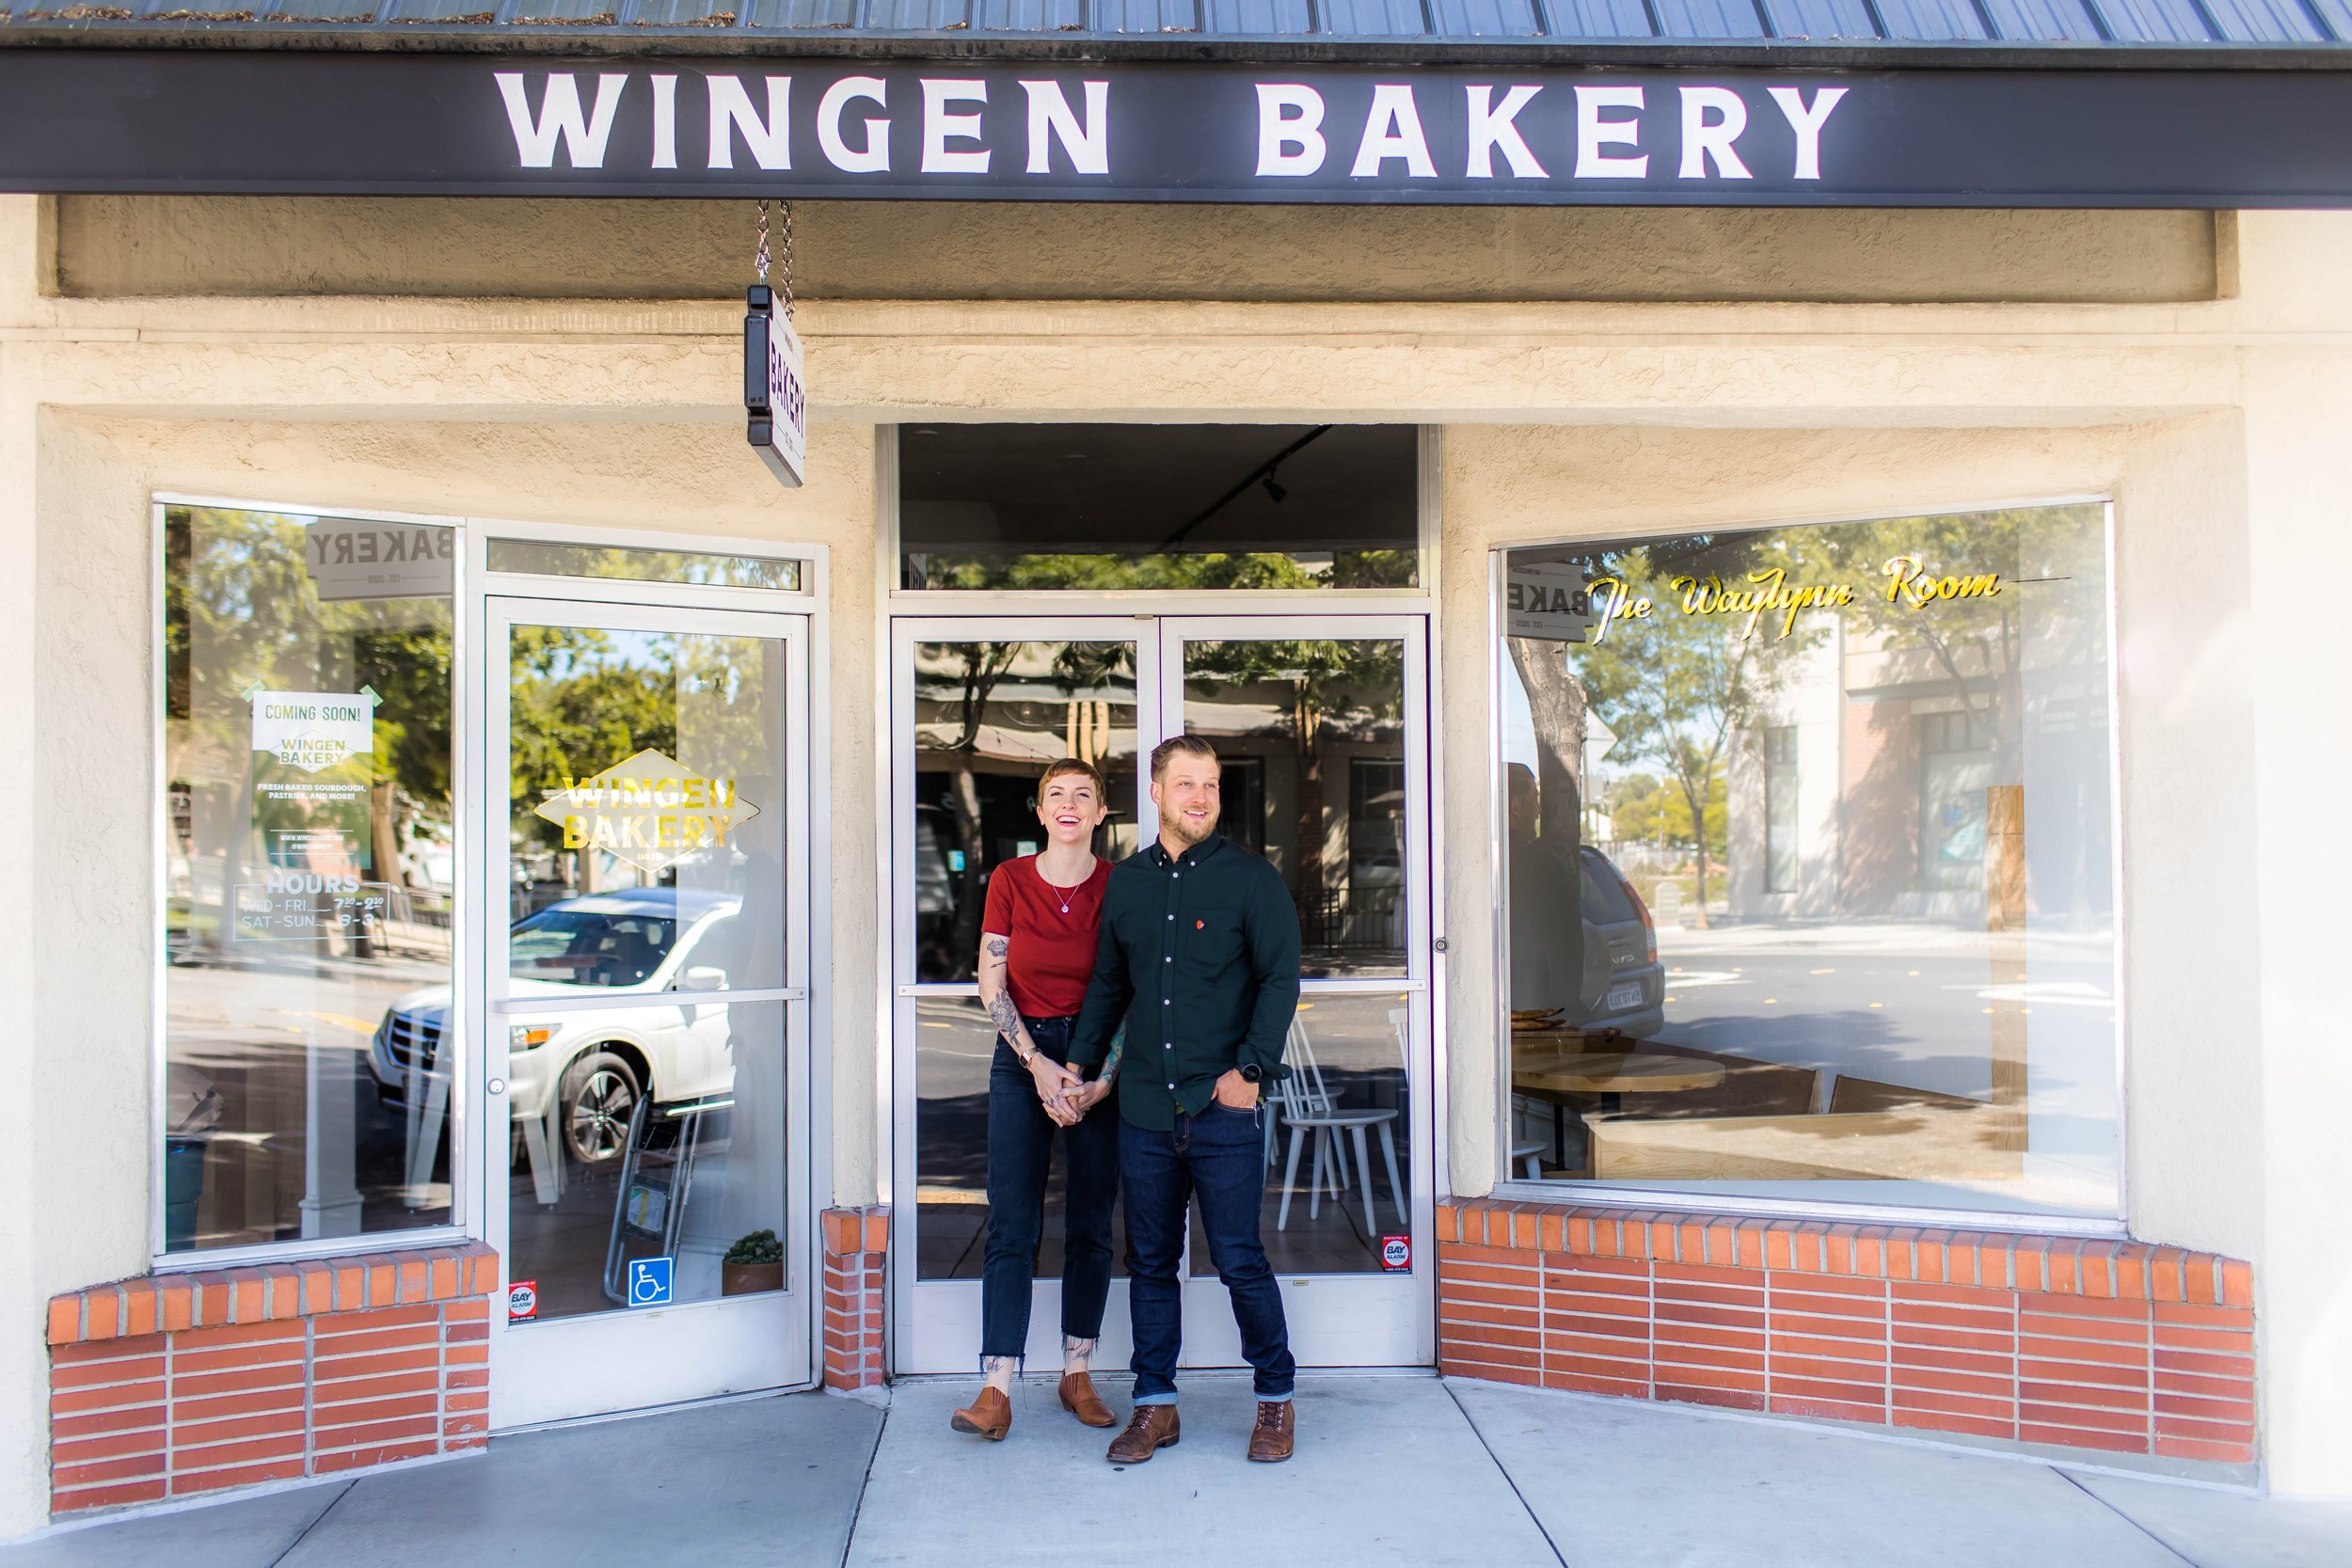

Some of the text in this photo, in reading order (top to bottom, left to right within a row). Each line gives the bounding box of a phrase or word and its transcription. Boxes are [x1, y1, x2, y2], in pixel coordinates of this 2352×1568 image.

[493, 72, 1850, 180] WINGEN BAKERY
[771, 340, 805, 439] BAKERY
[1585, 555, 2002, 646] The Waylynn Room
[265, 705, 361, 722] COMING SOON!
[281, 739, 345, 751] WINGEN
[280, 752, 344, 764] BAKERY
[314, 784, 367, 793] SOURDOUGH,
[562, 777, 736, 809] WINGEN
[563, 814, 734, 849] BAKERY
[266, 874, 360, 895] HOURS
[512, 1292, 532, 1302] BAY
